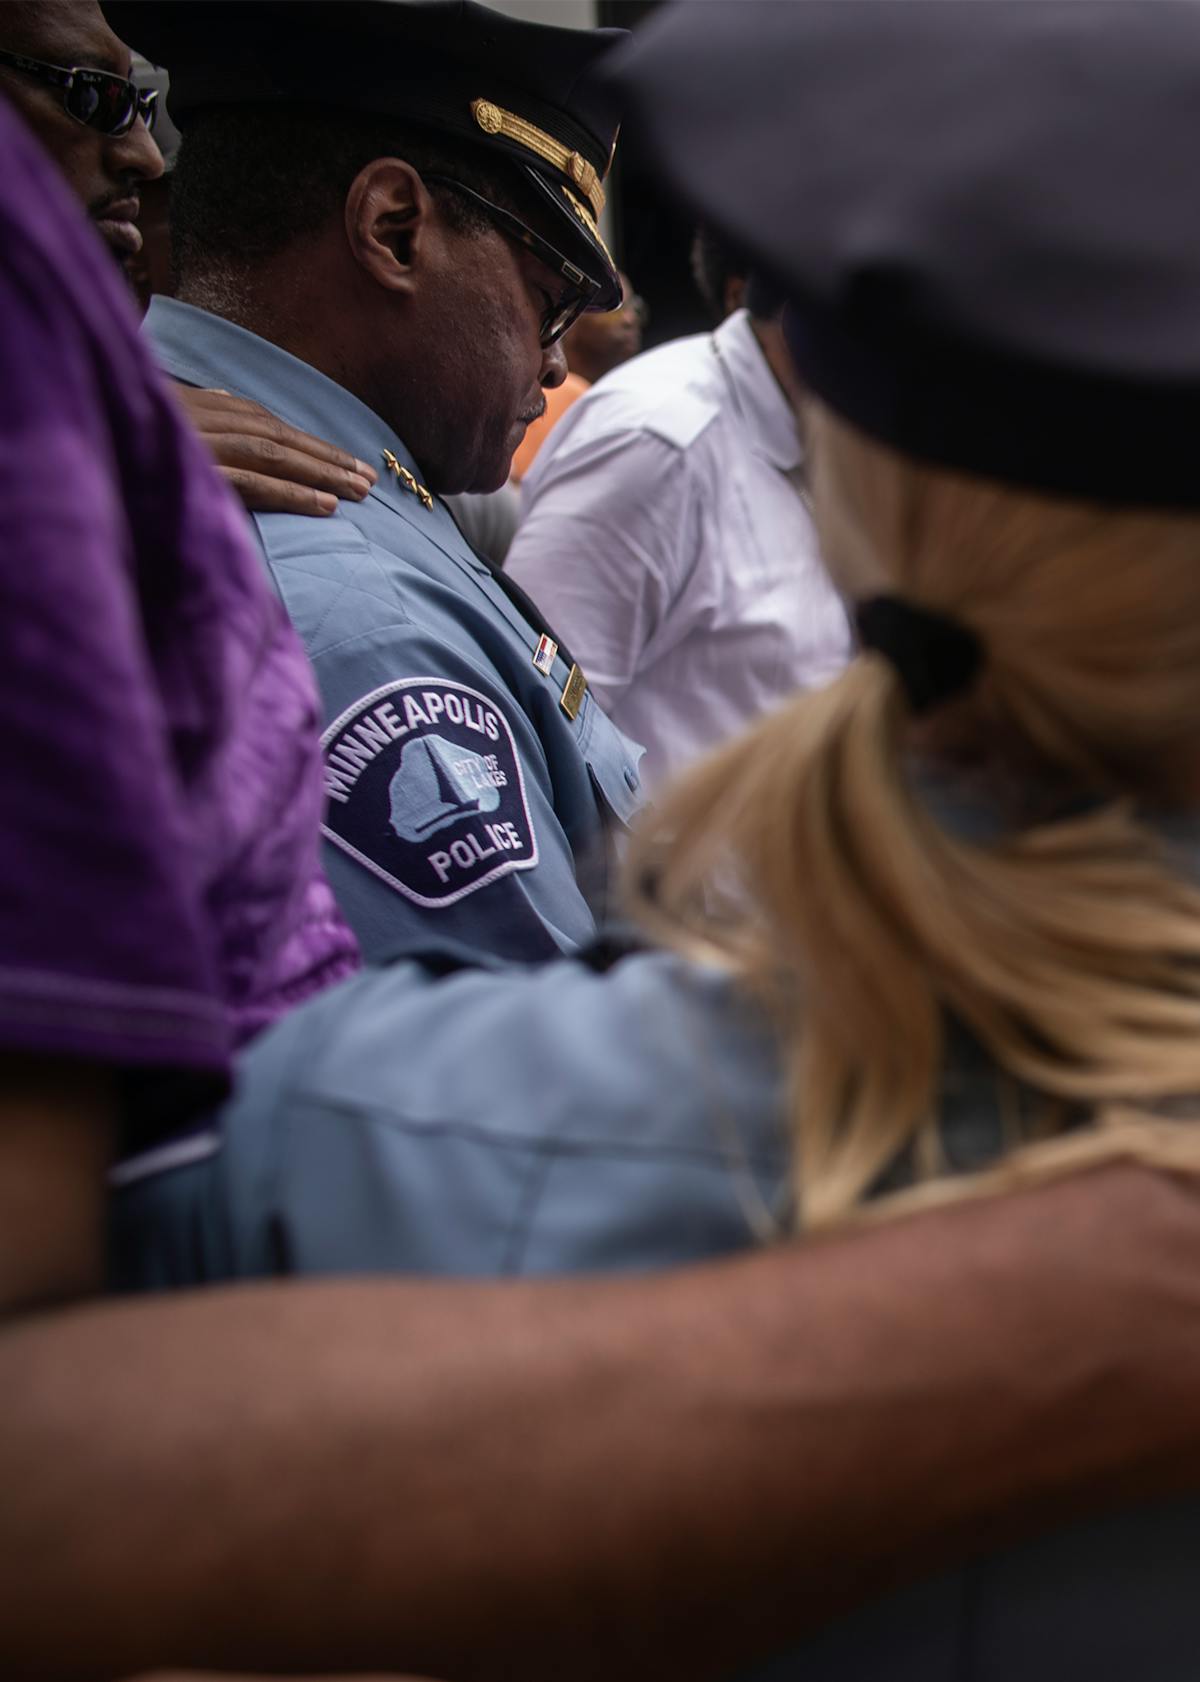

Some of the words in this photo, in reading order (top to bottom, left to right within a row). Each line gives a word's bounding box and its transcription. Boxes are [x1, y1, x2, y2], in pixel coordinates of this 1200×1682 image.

[323, 692, 499, 804] MINNEAPOLIS
[454, 757, 482, 776] CITY
[484, 754, 498, 771] OF
[471, 770, 508, 788] LAKES
[428, 822, 523, 883] POLICE
